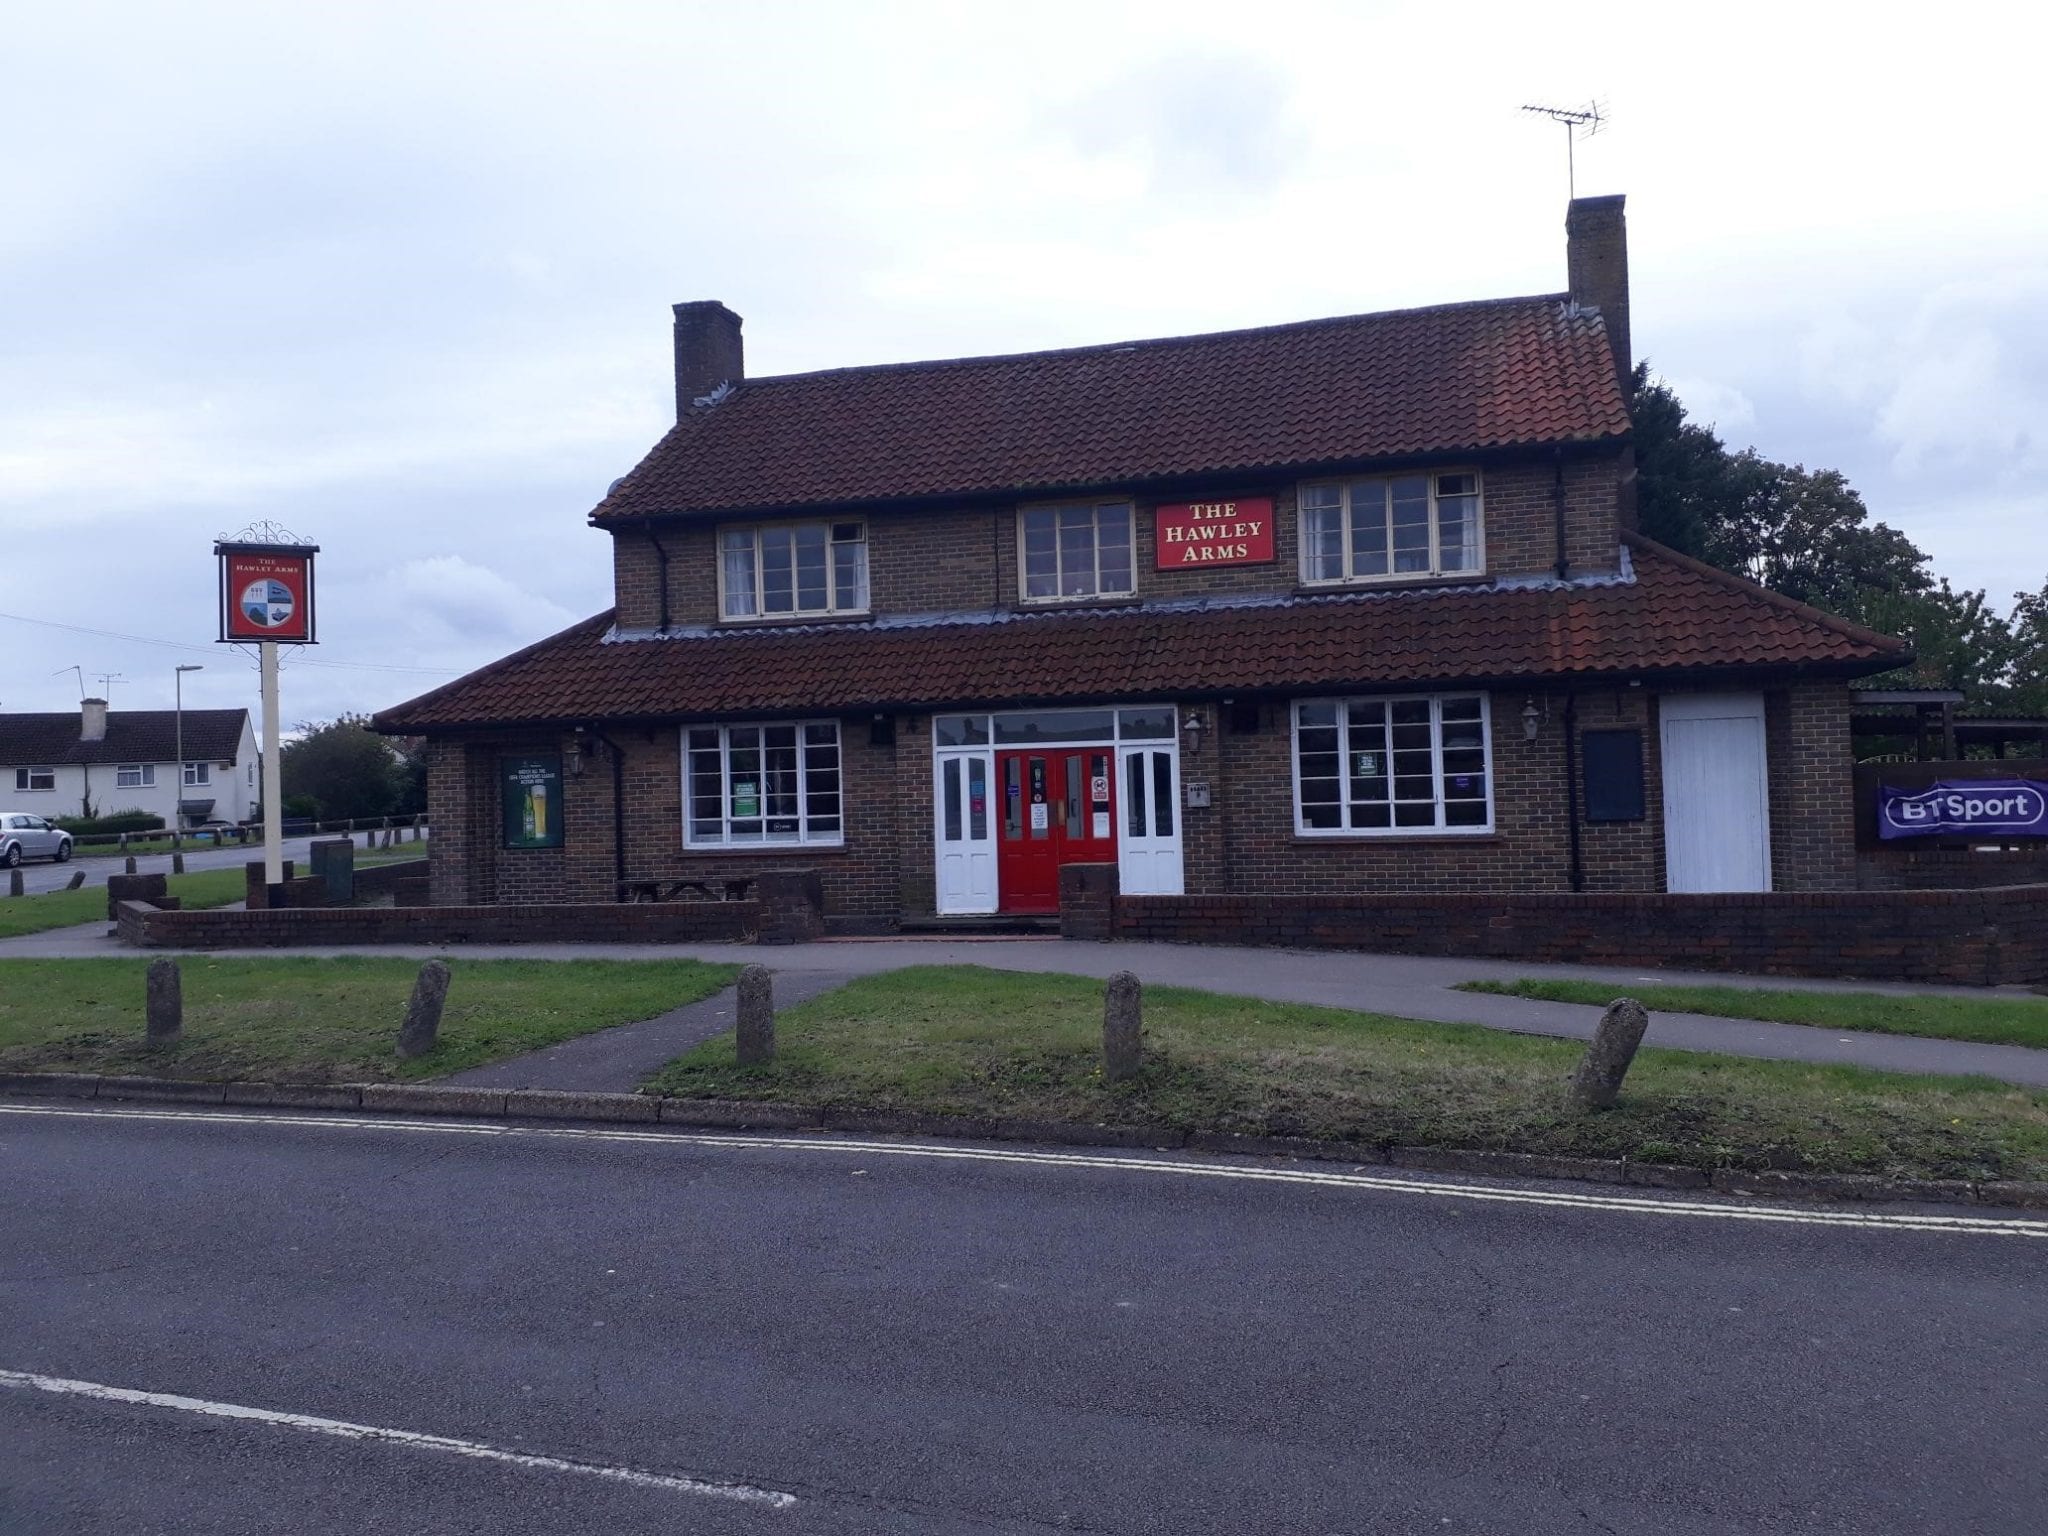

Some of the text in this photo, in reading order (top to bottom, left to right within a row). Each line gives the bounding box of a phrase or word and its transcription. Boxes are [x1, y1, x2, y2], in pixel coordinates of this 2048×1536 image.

[1189, 503, 1237, 520] THE
[1165, 521, 1262, 543] HAWLEY
[1182, 543, 1248, 562] ARMS
[236, 565, 271, 573] HAWLEY
[1902, 795, 2029, 821] BT Sport
